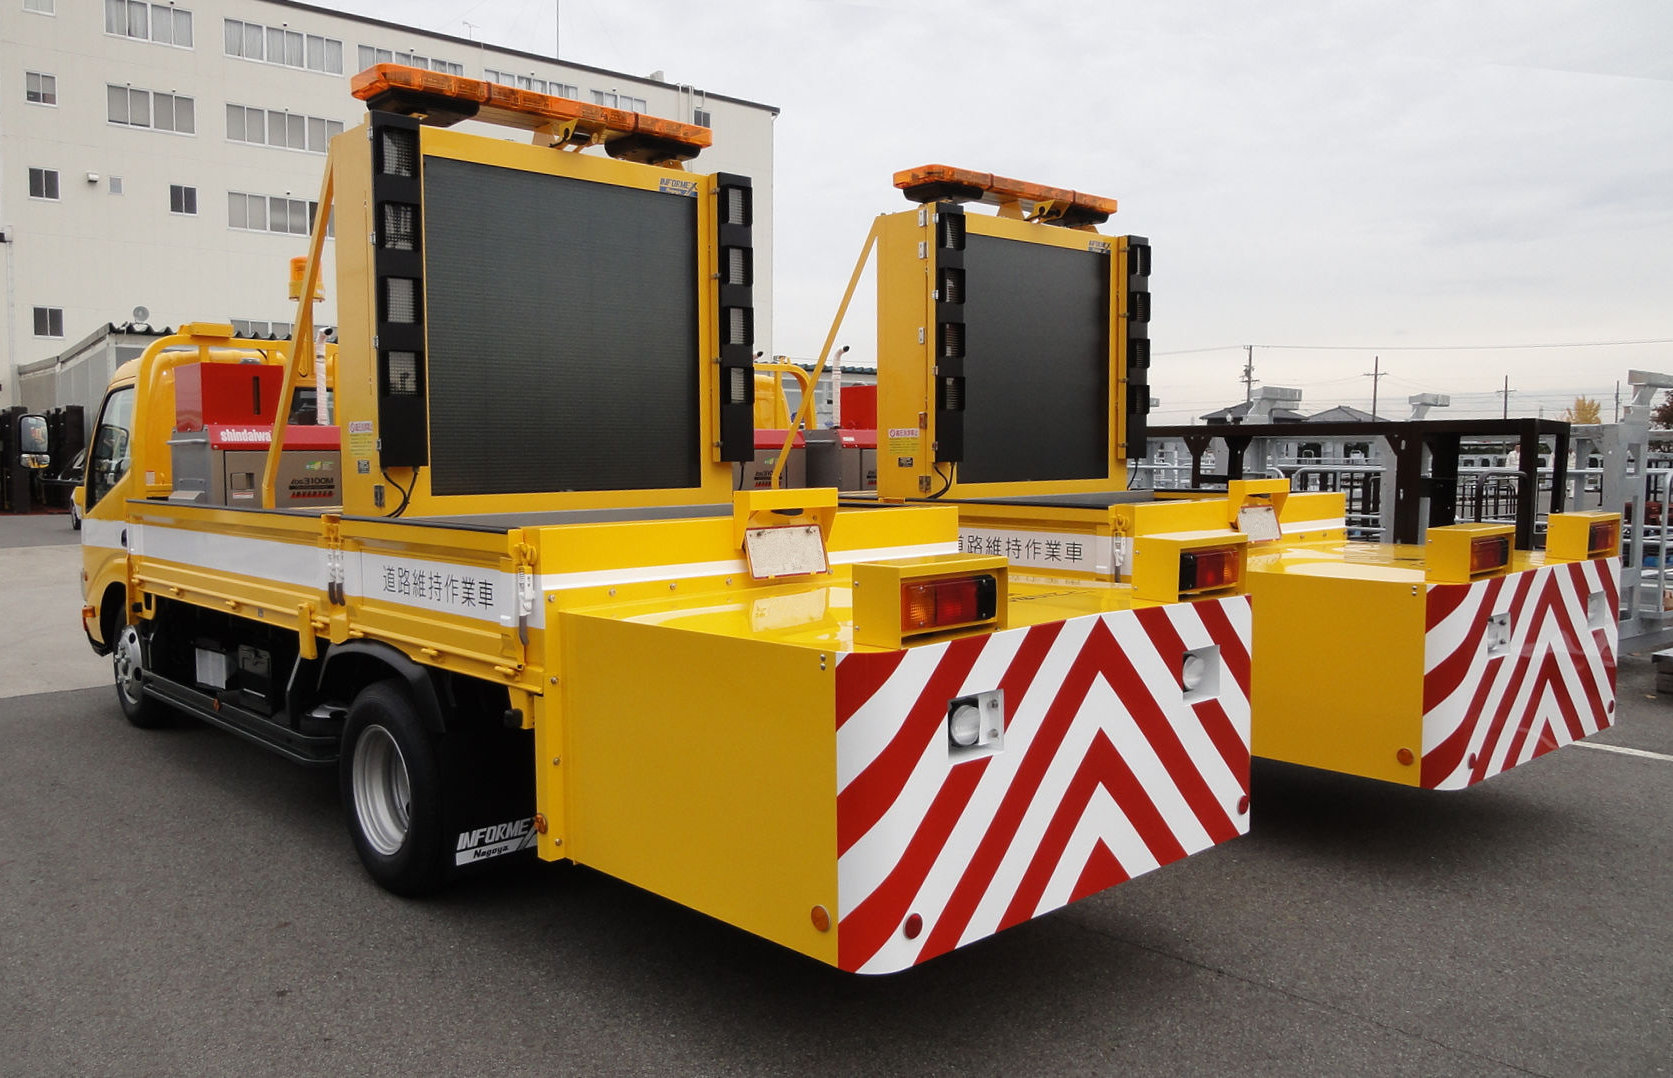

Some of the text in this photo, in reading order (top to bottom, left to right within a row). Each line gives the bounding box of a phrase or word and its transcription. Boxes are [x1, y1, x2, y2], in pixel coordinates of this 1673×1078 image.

[220, 428, 272, 442] shindaiwa
[382, 564, 494, 610] 道路維持作業車
[473, 845, 509, 859] Nagoya
